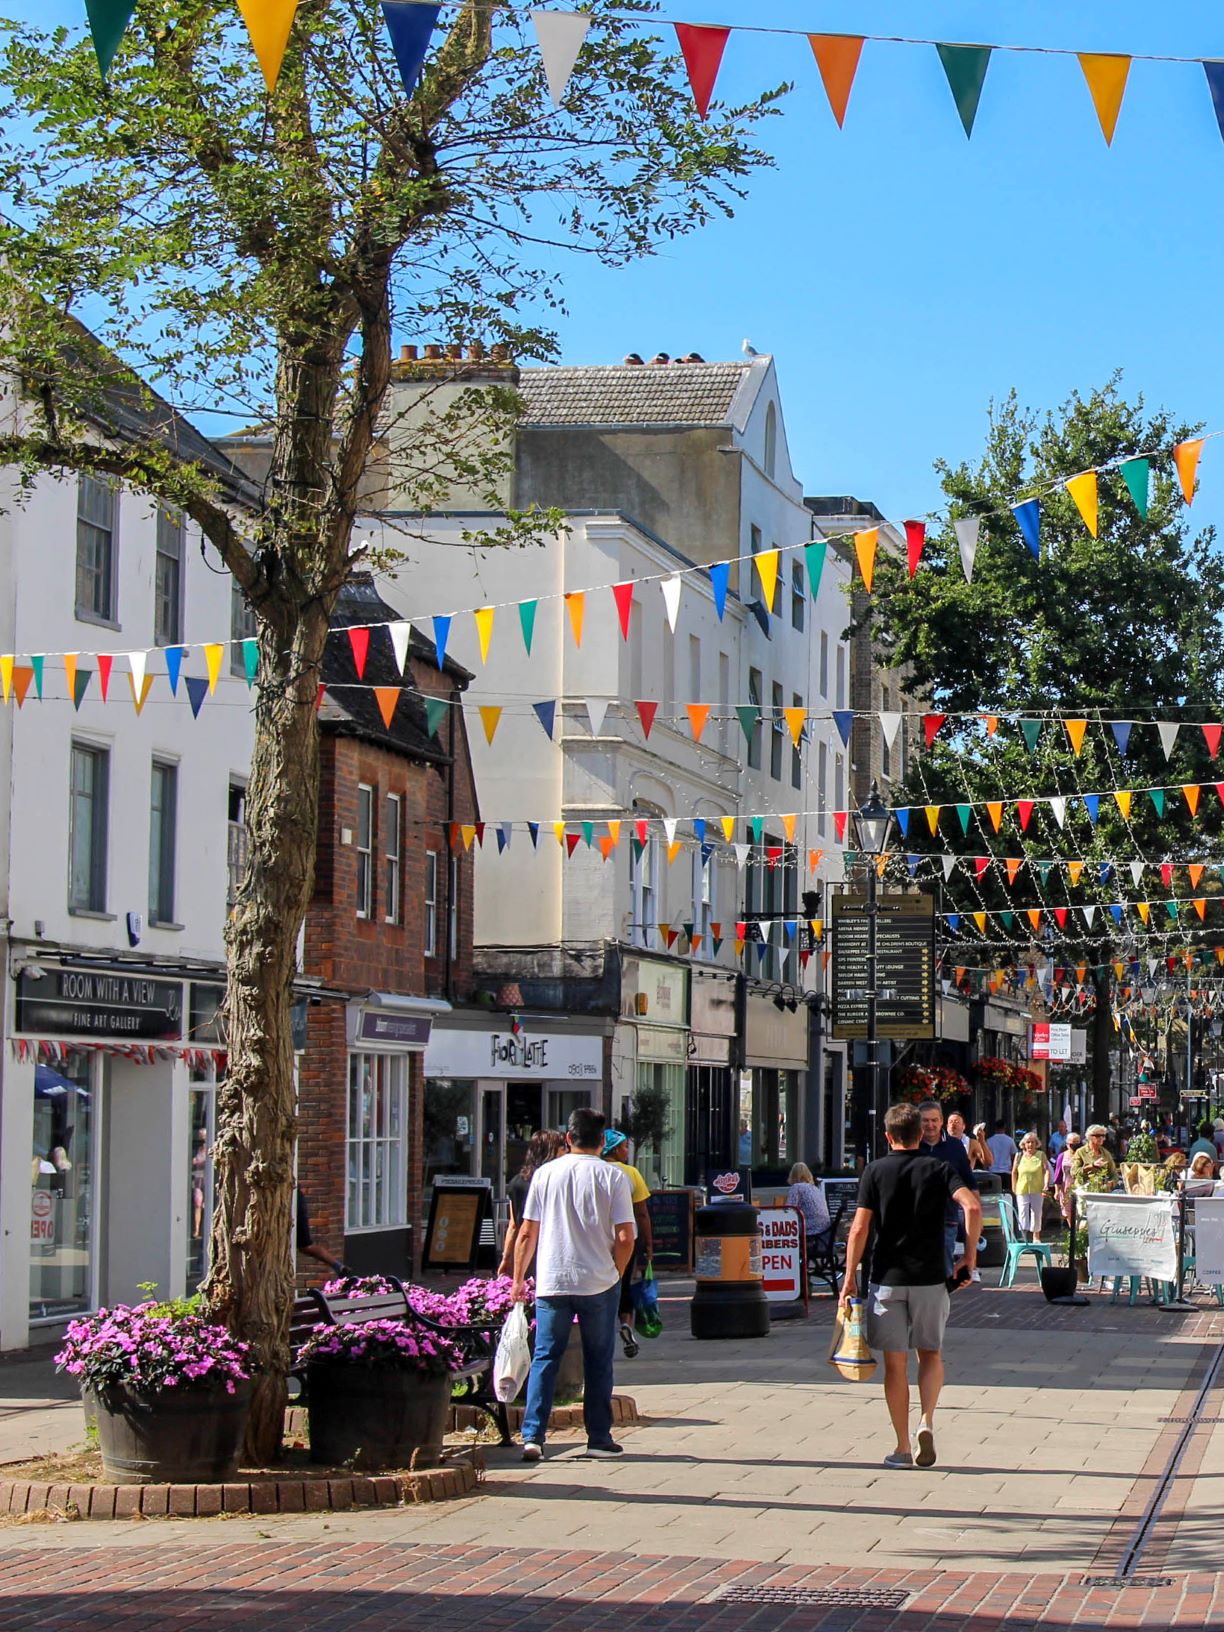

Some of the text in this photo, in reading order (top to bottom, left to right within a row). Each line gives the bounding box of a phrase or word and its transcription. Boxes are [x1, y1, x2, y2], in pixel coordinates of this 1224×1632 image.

[62, 974, 157, 1004] ROOM WITH A VIEW
[73, 1012, 142, 1030] FINE ART GALLERY
[765, 1224, 771, 1235] &
[772, 1221, 798, 1237] DADS
[761, 1238, 798, 1249] RBERS
[762, 1255, 792, 1270] PEN
